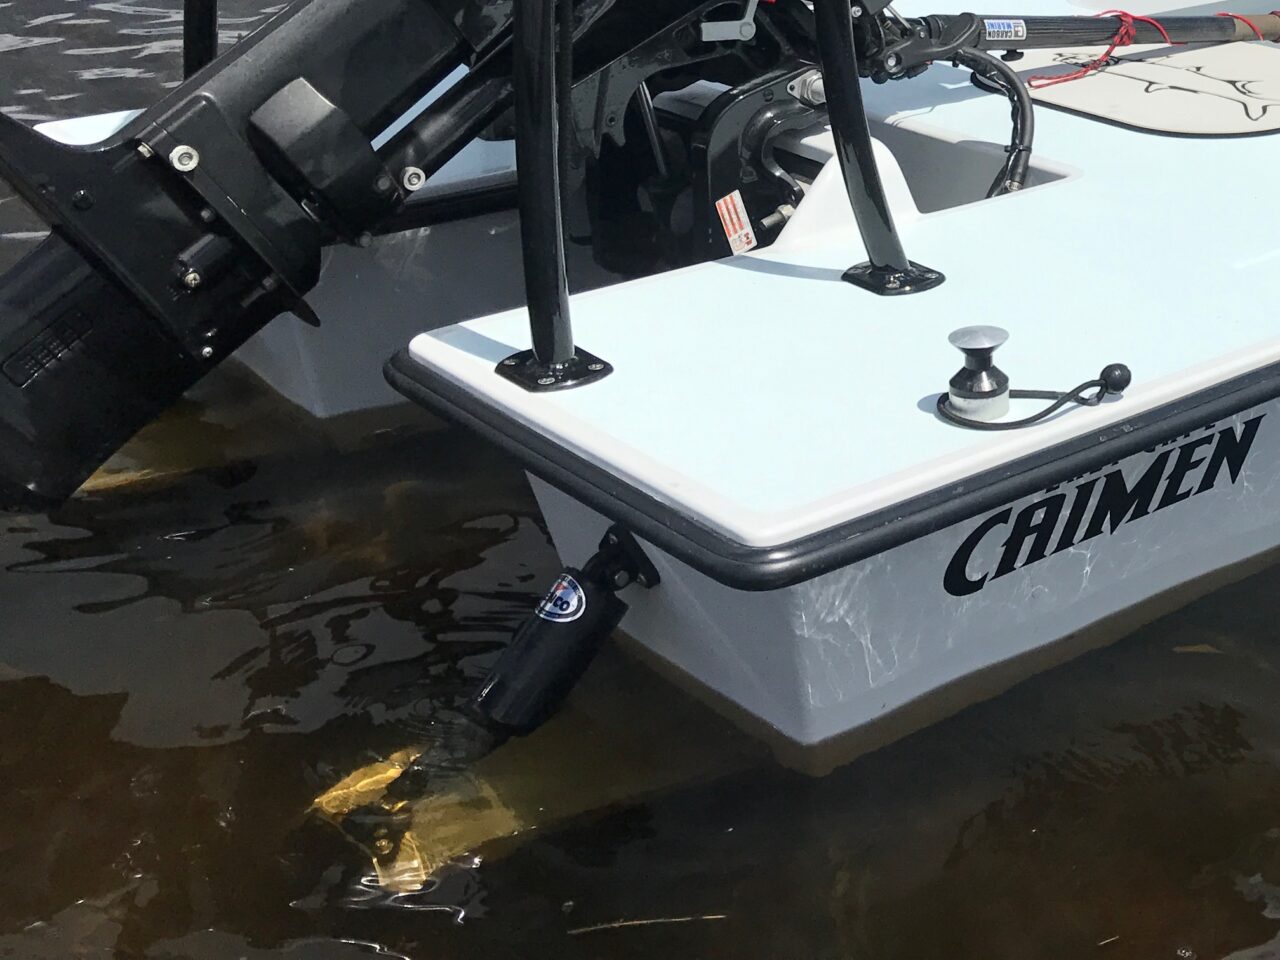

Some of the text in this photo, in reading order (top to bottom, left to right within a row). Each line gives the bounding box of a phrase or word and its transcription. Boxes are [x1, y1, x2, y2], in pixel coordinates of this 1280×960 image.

[986, 22, 1012, 30] MARINE
[987, 30, 1012, 38] CARBON
[943, 414, 1267, 596] CAIMEN
